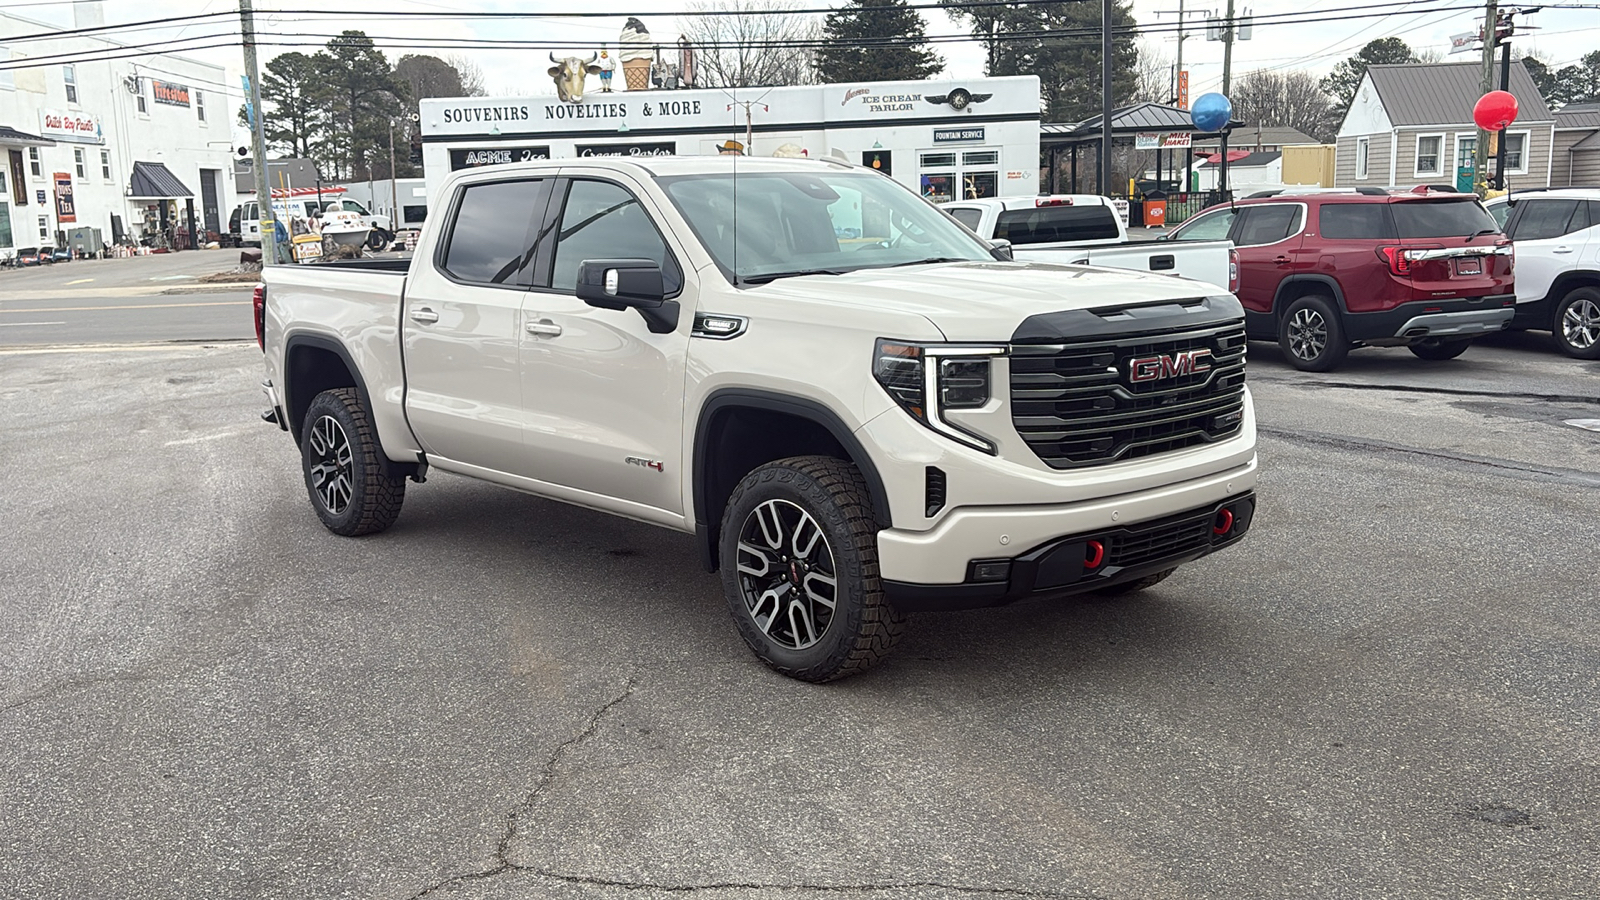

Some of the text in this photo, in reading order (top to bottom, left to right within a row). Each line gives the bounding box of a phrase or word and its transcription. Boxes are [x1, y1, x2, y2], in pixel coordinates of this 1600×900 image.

[153, 81, 189, 102] Firestone
[842, 88, 870, 106] Acme
[882, 94, 921, 102] CREAM
[444, 100, 702, 123] SOUVENIRS NOVELTIES & MORE
[870, 104, 914, 112] PARLOR
[46, 115, 94, 133] Dutch Boy Paints
[936, 130, 982, 140] FOUNTAIN SERVICE
[466, 150, 512, 164] ACME
[520, 150, 548, 162] Ice
[629, 147, 673, 157] Parlor
[61, 201, 73, 213] TEA
[1130, 348, 1211, 383] GMC
[625, 456, 664, 472] AT4
